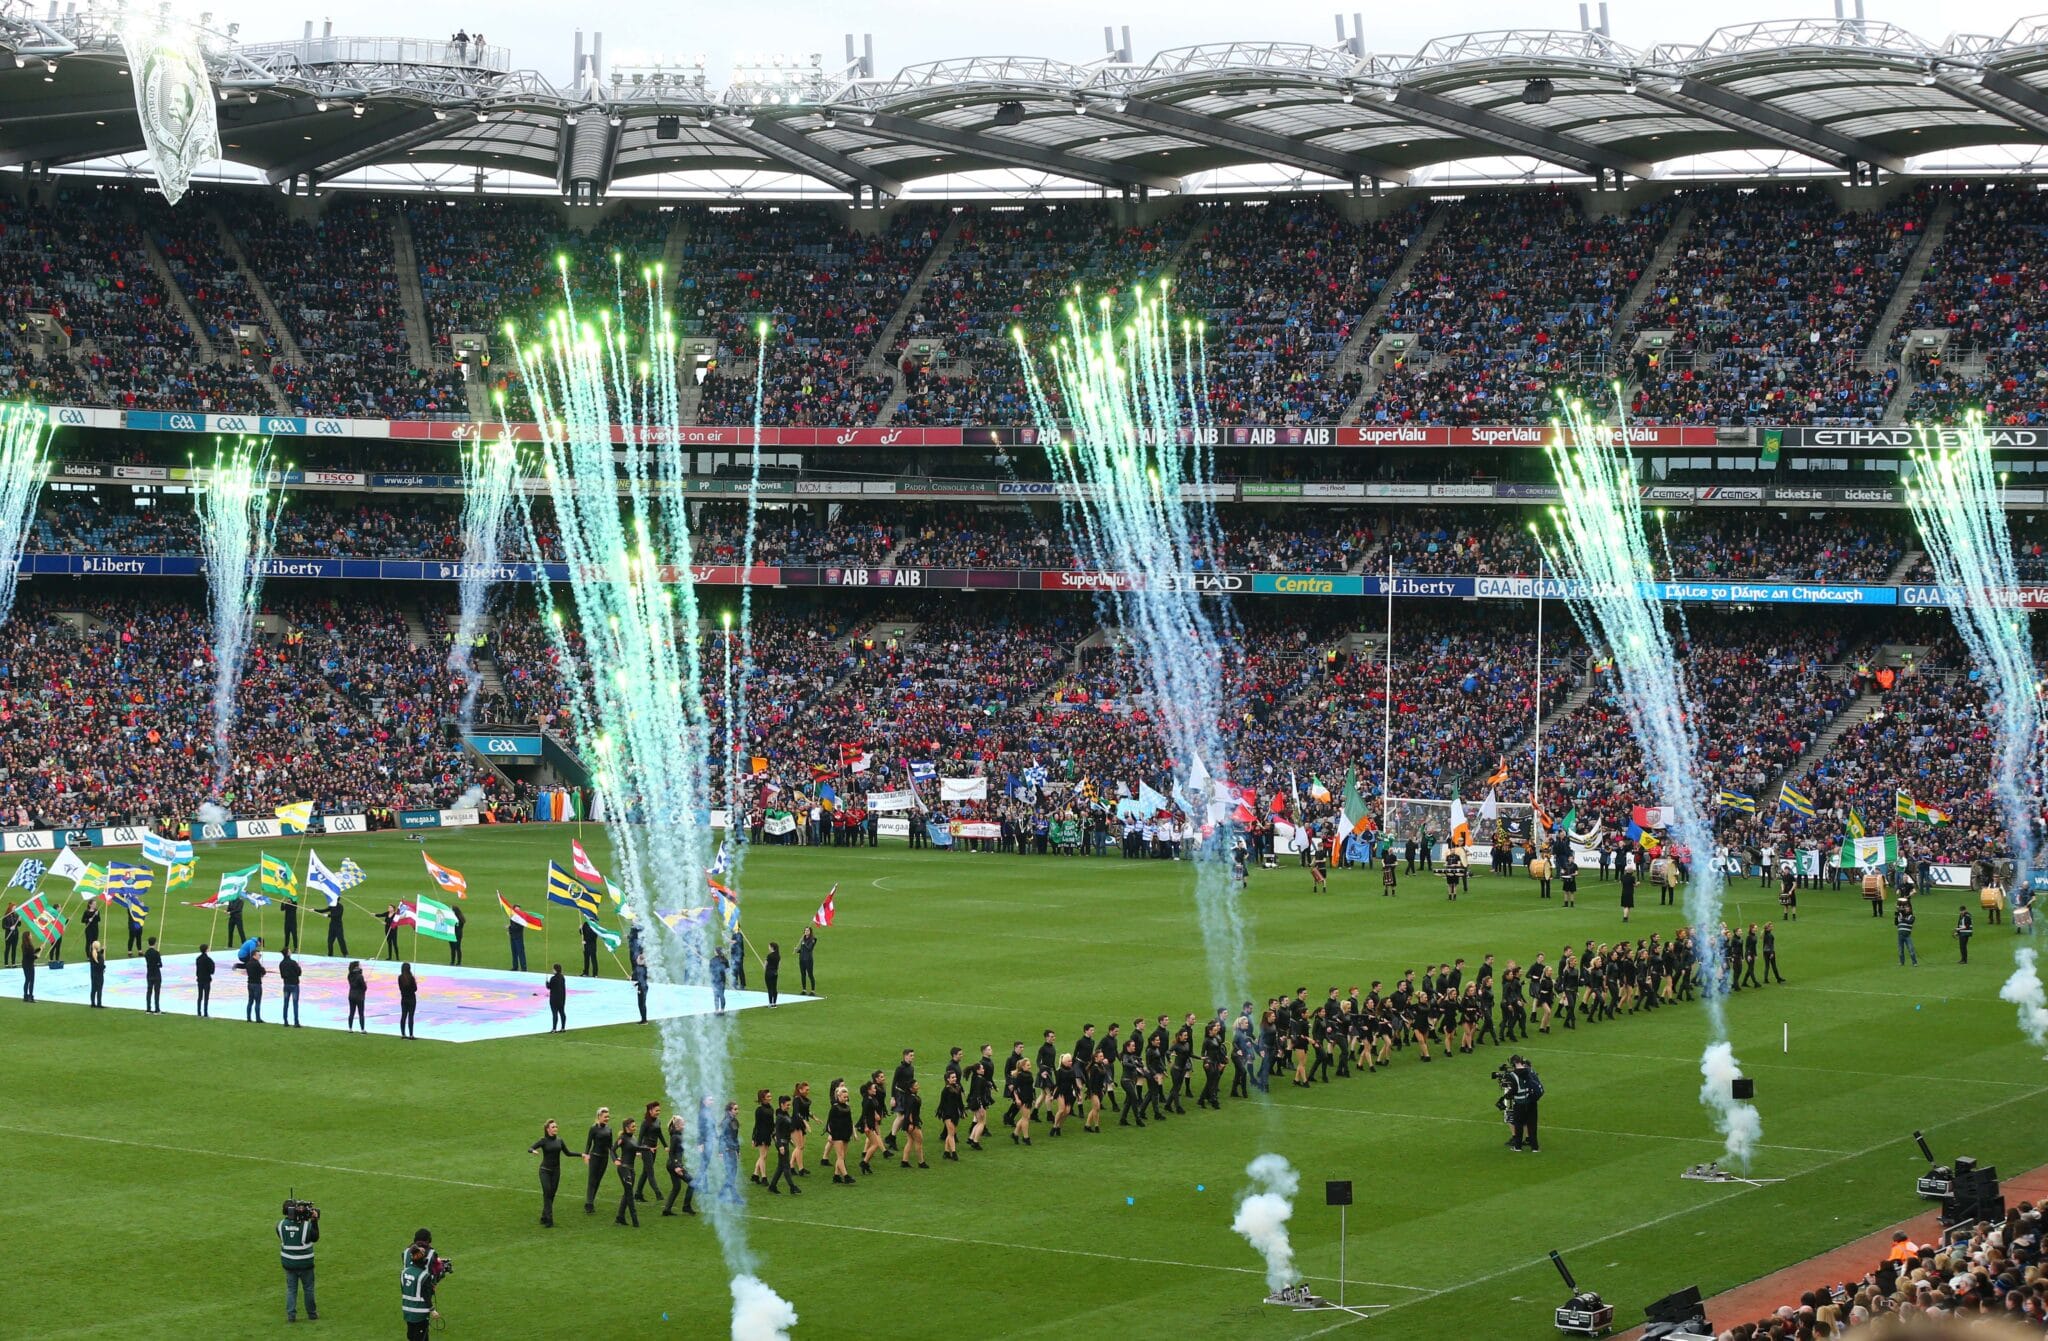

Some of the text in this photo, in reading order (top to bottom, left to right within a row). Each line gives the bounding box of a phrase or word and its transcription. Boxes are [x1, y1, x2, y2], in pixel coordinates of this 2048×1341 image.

[59, 409, 85, 424] GAA
[170, 414, 195, 429] GAA
[217, 417, 247, 431] GAA
[268, 419, 297, 433] GAA
[315, 421, 343, 434] GAA
[688, 433, 704, 442] on
[707, 430, 723, 442] eir
[837, 428, 859, 444] eir
[881, 429, 902, 444] eir
[1036, 429, 1060, 444] AIB
[1193, 429, 1219, 444] AIB
[1250, 429, 1276, 444] AIB
[1303, 429, 1330, 445] AIB
[1358, 428, 1427, 446] SuperValu
[1472, 428, 1541, 445] SuperValu
[1814, 431, 1913, 445] ETIHAD
[1940, 431, 2037, 445] EHAD
[65, 464, 101, 476] tickets.ie
[316, 473, 355, 481] TESCO
[384, 477, 423, 485] www.cgl.ie
[1001, 483, 1054, 493] DIXON
[1653, 490, 1688, 499] CEMEX
[1721, 491, 1758, 499] CEMEX
[1775, 490, 1822, 499] tickets.ie
[1845, 490, 1893, 500] tickets.ie
[93, 558, 145, 574] Liberty
[263, 561, 323, 577] Liberty
[452, 563, 517, 581] Liberty
[842, 570, 868, 585] AIB
[894, 570, 921, 585] AIB
[1062, 573, 1124, 589] SuperValu
[1275, 577, 1333, 593] Centra
[1392, 580, 1456, 595] Liberty
[1478, 581, 1530, 595] GAA.ie
[1711, 589, 1726, 600] go
[1730, 585, 1768, 602] Páirc
[1771, 590, 1788, 599] an
[488, 739, 518, 753] GAA
[335, 817, 355, 831] GAA
[406, 815, 435, 825] www.gaa.ie
[114, 827, 141, 842] GAA
[202, 824, 226, 838] GAA
[248, 821, 274, 835] GAA
[16, 833, 42, 848] GAA
